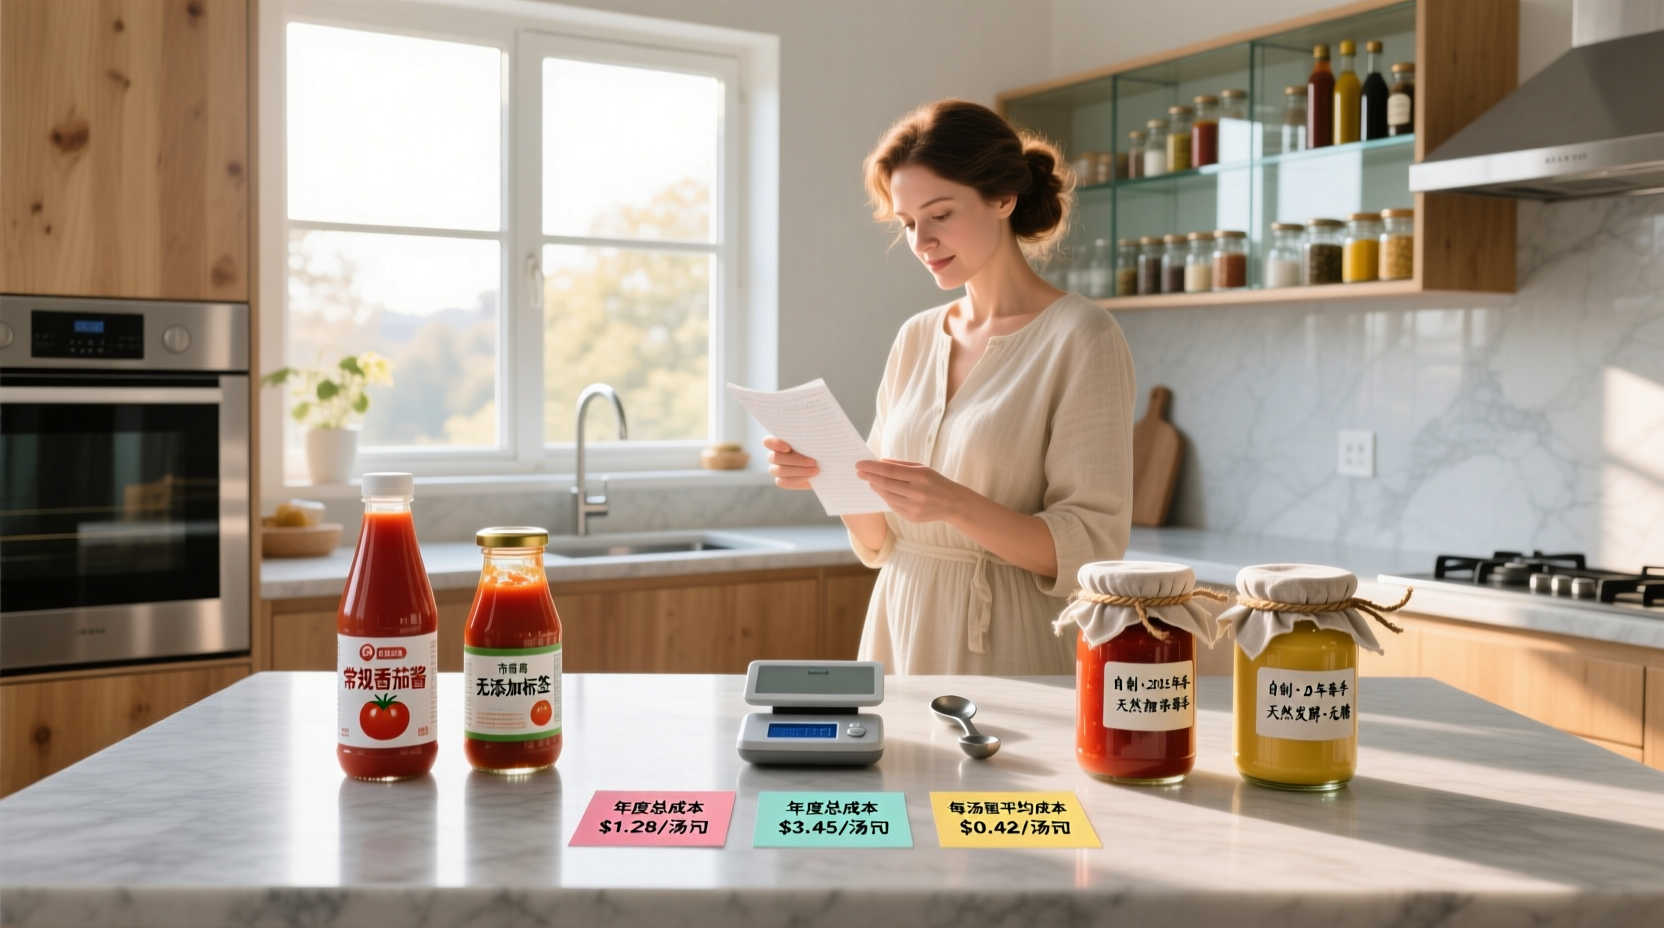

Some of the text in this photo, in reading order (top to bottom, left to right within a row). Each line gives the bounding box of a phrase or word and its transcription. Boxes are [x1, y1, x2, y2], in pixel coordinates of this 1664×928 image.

[613, 799, 705, 816] 年度总成本
[785, 799, 879, 817] 年度总成本
